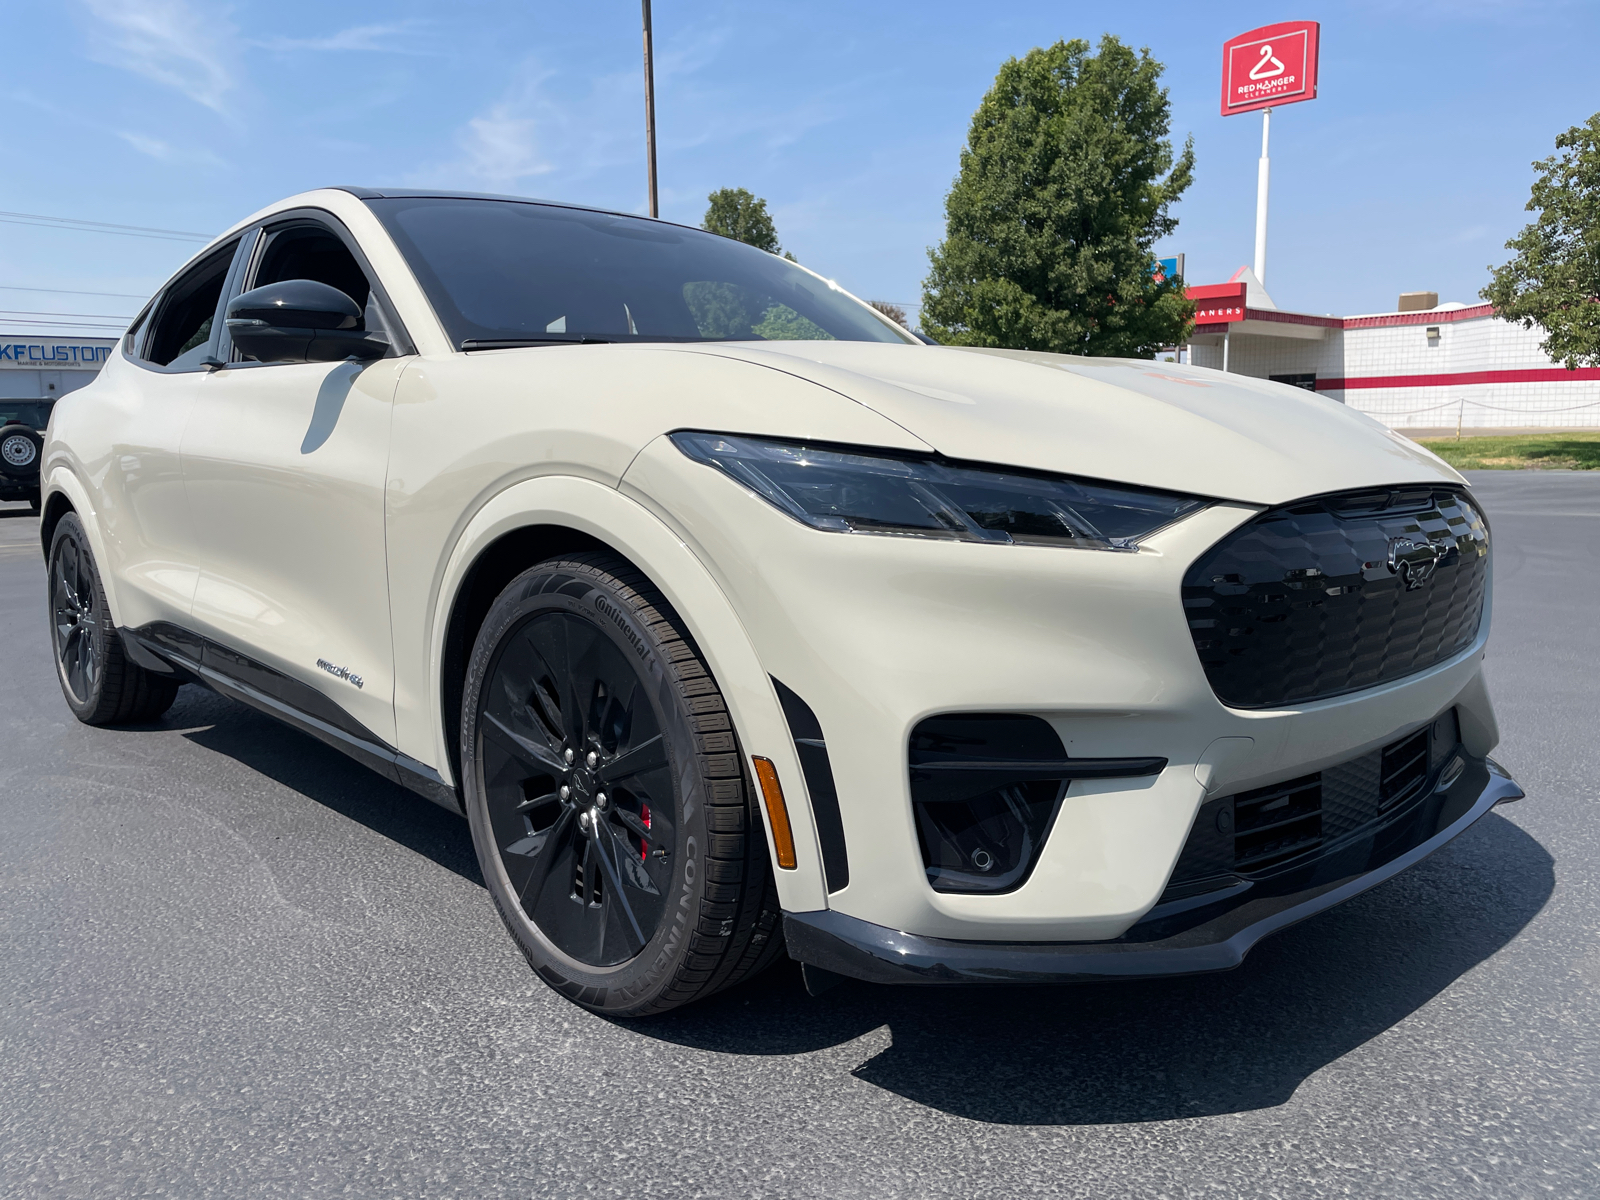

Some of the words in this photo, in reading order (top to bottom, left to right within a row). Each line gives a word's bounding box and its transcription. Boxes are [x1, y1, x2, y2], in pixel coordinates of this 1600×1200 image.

[1238, 84, 1256, 95] RED
[1256, 75, 1295, 90] HANGER
[1244, 85, 1287, 98] CLEANERS
[594, 594, 651, 661] Continental
[613, 835, 698, 1001] CONTINENTAL
